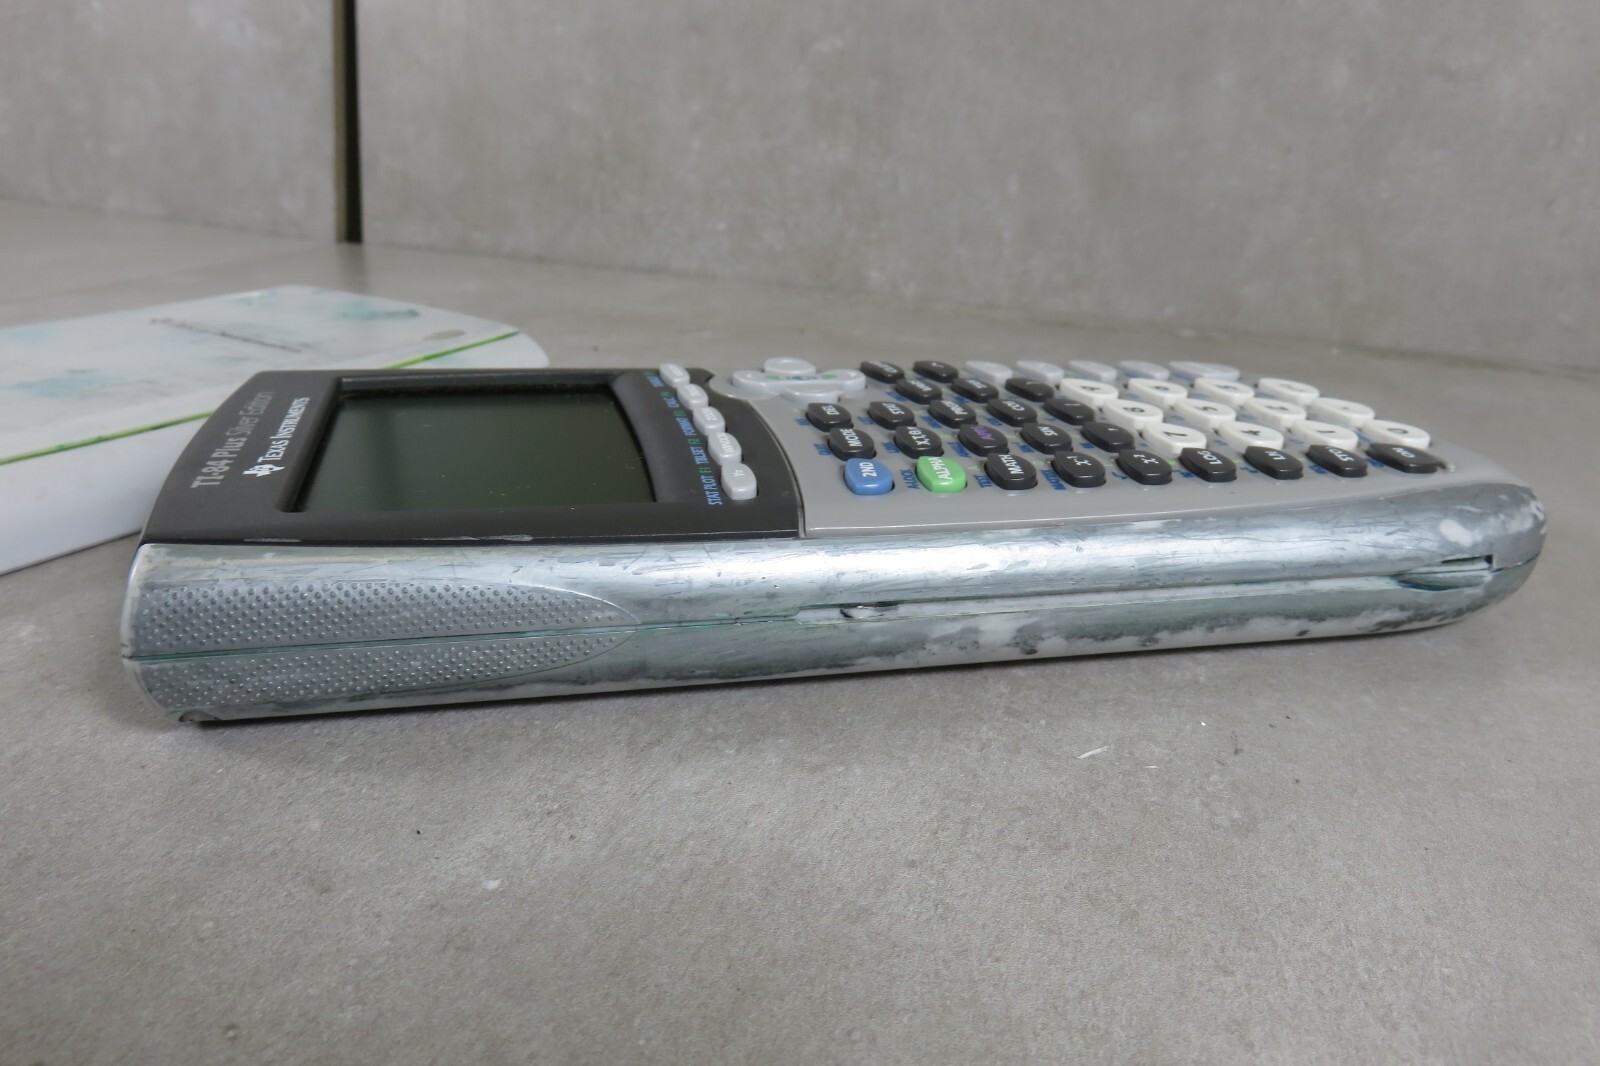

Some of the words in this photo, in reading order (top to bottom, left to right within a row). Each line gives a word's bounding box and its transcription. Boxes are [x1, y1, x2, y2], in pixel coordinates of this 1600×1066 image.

[239, 391, 274, 415] Edition
[821, 405, 840, 415] DEL
[882, 402, 905, 415] STAT
[225, 417, 260, 435] Silver
[270, 397, 310, 438] INSTRUMENTS
[840, 428, 863, 447] MODE
[1037, 426, 1059, 436] SIN
[211, 437, 248, 458] Plus
[257, 440, 290, 463] TEXAS
[997, 454, 1025, 474] MATH
[1197, 450, 1223, 465] LOG
[190, 459, 234, 488] TI-84
[859, 462, 878, 477] 2ND
[927, 456, 953, 480] ALPHA
[701, 475, 718, 491] PLOT
[706, 491, 723, 505] STAT
